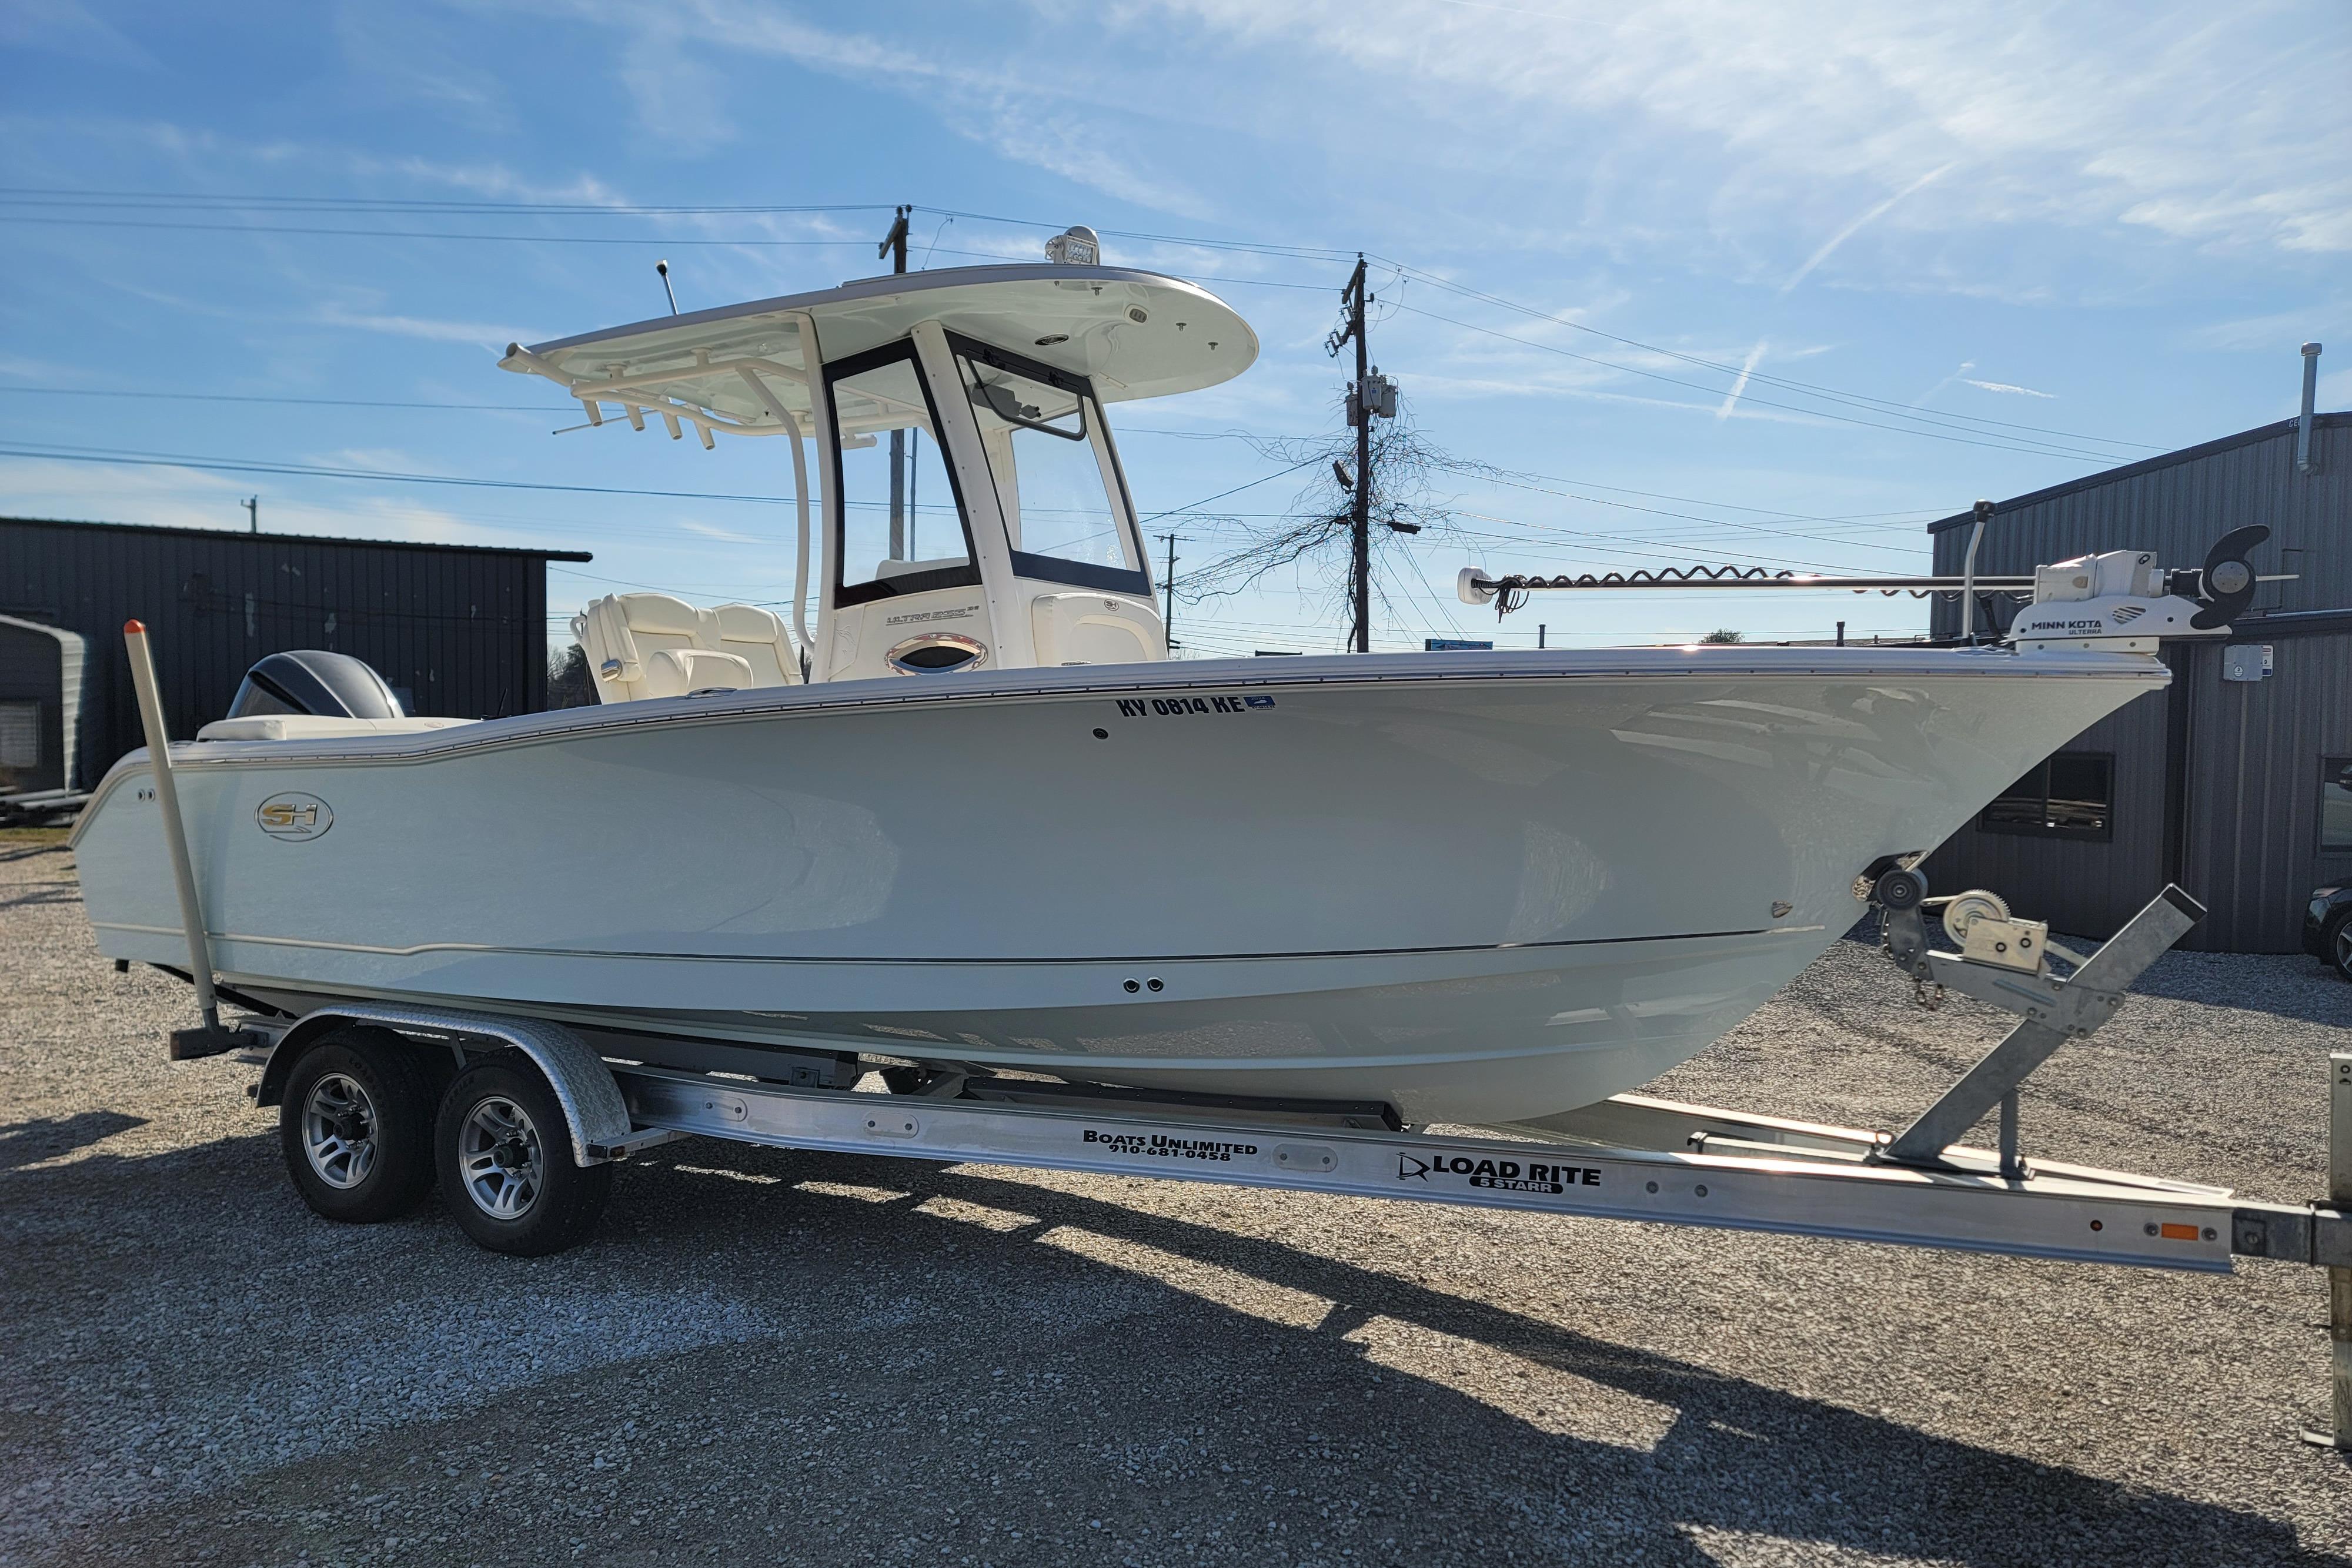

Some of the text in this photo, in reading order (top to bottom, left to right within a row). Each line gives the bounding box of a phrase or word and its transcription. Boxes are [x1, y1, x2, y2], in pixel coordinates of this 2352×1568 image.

[887, 613, 930, 623] ULTRA
[932, 609, 966, 618] 255
[2032, 620, 2102, 630] MINN KOTA
[1115, 697, 1245, 717] KY 0814 KE
[1083, 1130, 1258, 1155] BOATS UNLIMITED
[1108, 1144, 1231, 1161] 910-681-0458
[1433, 1155, 1602, 1186] LOAD RITE
[1480, 1178, 1552, 1192] 5 STARR
